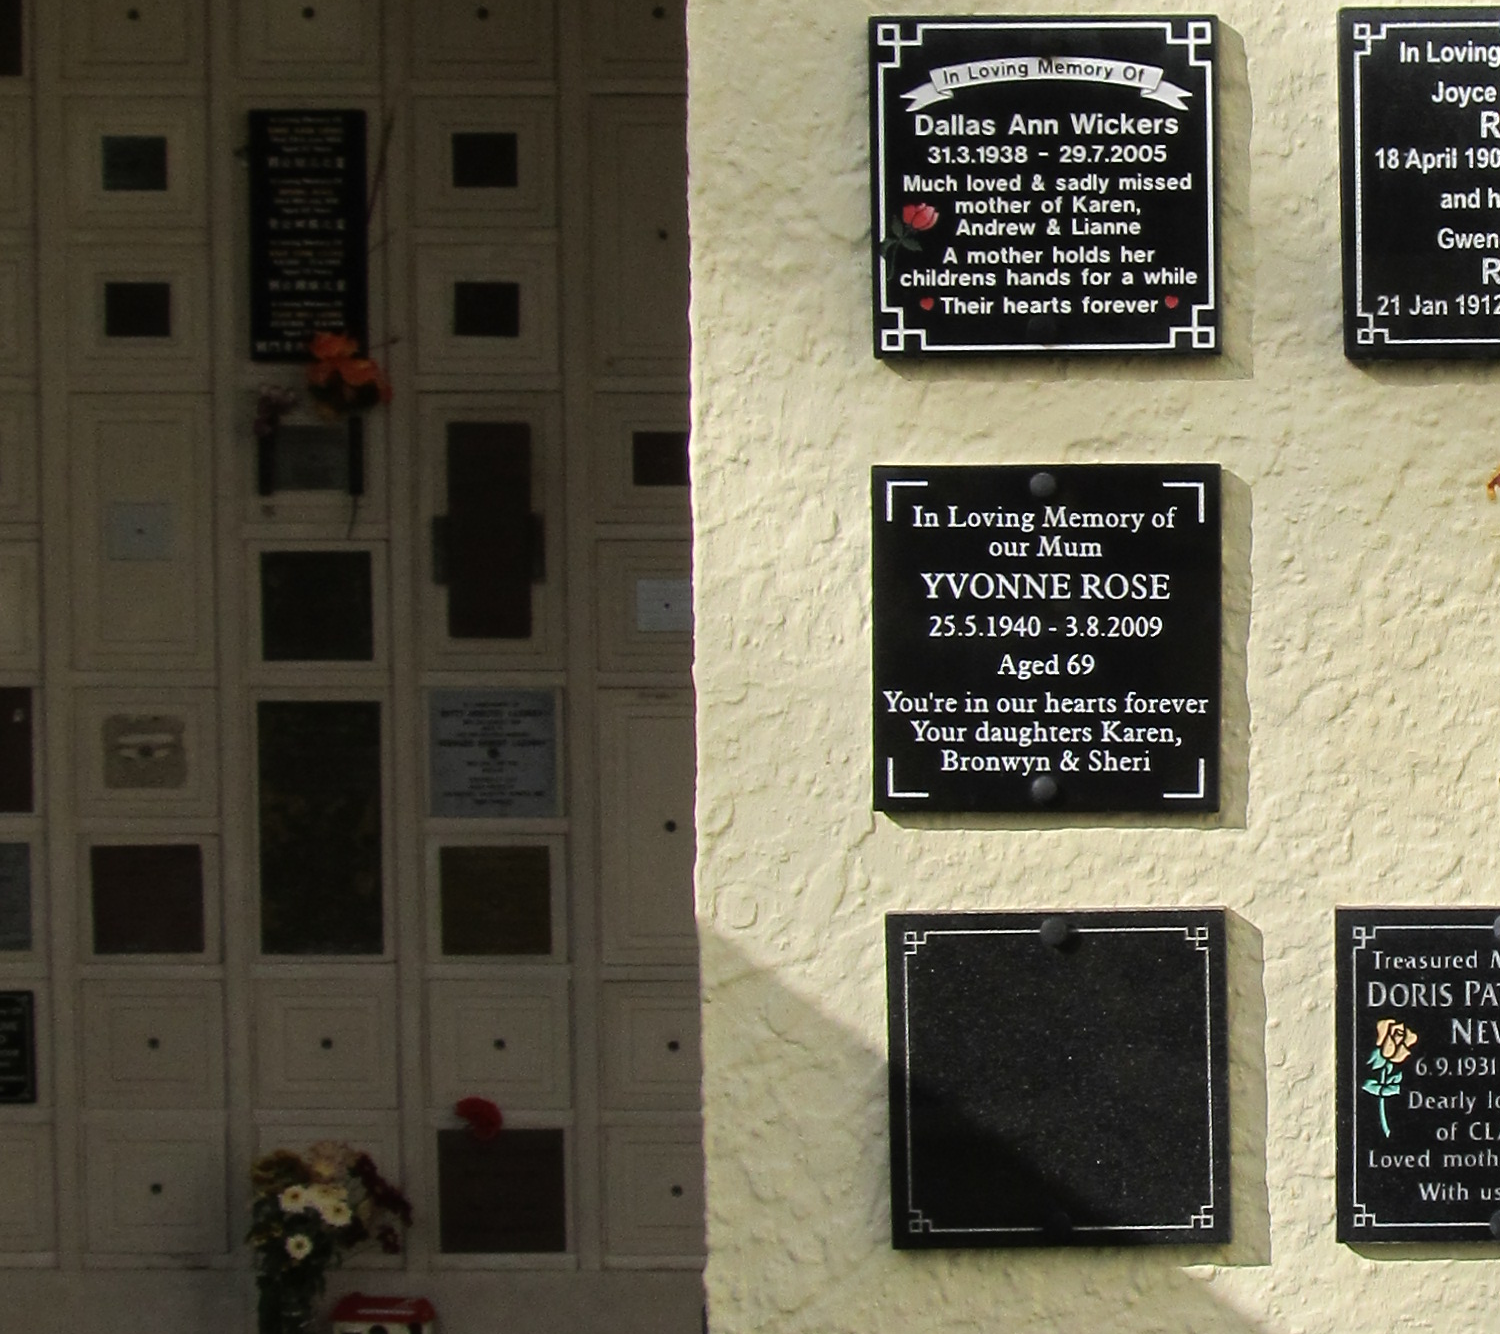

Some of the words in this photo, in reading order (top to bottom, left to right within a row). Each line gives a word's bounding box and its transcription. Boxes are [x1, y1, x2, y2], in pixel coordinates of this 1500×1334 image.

[943, 68, 960, 85] In
[967, 61, 1030, 81] Loving
[1036, 58, 1115, 81] Memory
[1122, 66, 1146, 83] Of
[1431, 81, 1497, 108] Joyce
[915, 114, 996, 136] Dallas
[1008, 113, 1059, 135] Ann
[1070, 113, 1179, 135] Wickers
[927, 145, 1028, 164] 31.3.1938
[1059, 145, 1167, 163] 29.7.2005
[1375, 147, 1399, 169] 18
[1404, 147, 1457, 174] April
[903, 174, 957, 192] Much
[967, 174, 1021, 192] loved
[1031, 174, 1045, 191] &
[1055, 173, 1109, 194] sadly
[1119, 172, 1192, 191] missed
[1440, 187, 1480, 209] and
[989, 542, 1030, 557] our
[1036, 535, 1102, 557] Mum
[920, 573, 1071, 599] YVONNE
[1080, 573, 1170, 600] ROSE
[929, 615, 1041, 637] 25.5.1940
[1066, 616, 1163, 637] 3.8.2009
[910, 720, 967, 742] Your
[975, 721, 1092, 747] daughters
[1101, 720, 1182, 747] Karen,
[941, 749, 1051, 776] Bronwyn
[1059, 750, 1080, 771] &
[1088, 749, 1151, 771] Sheri
[1372, 950, 1477, 969] Treasured
[1367, 981, 1453, 1007] DORIS
[1415, 1057, 1496, 1076] 6.9.1931
[1436, 1122, 1458, 1141] of
